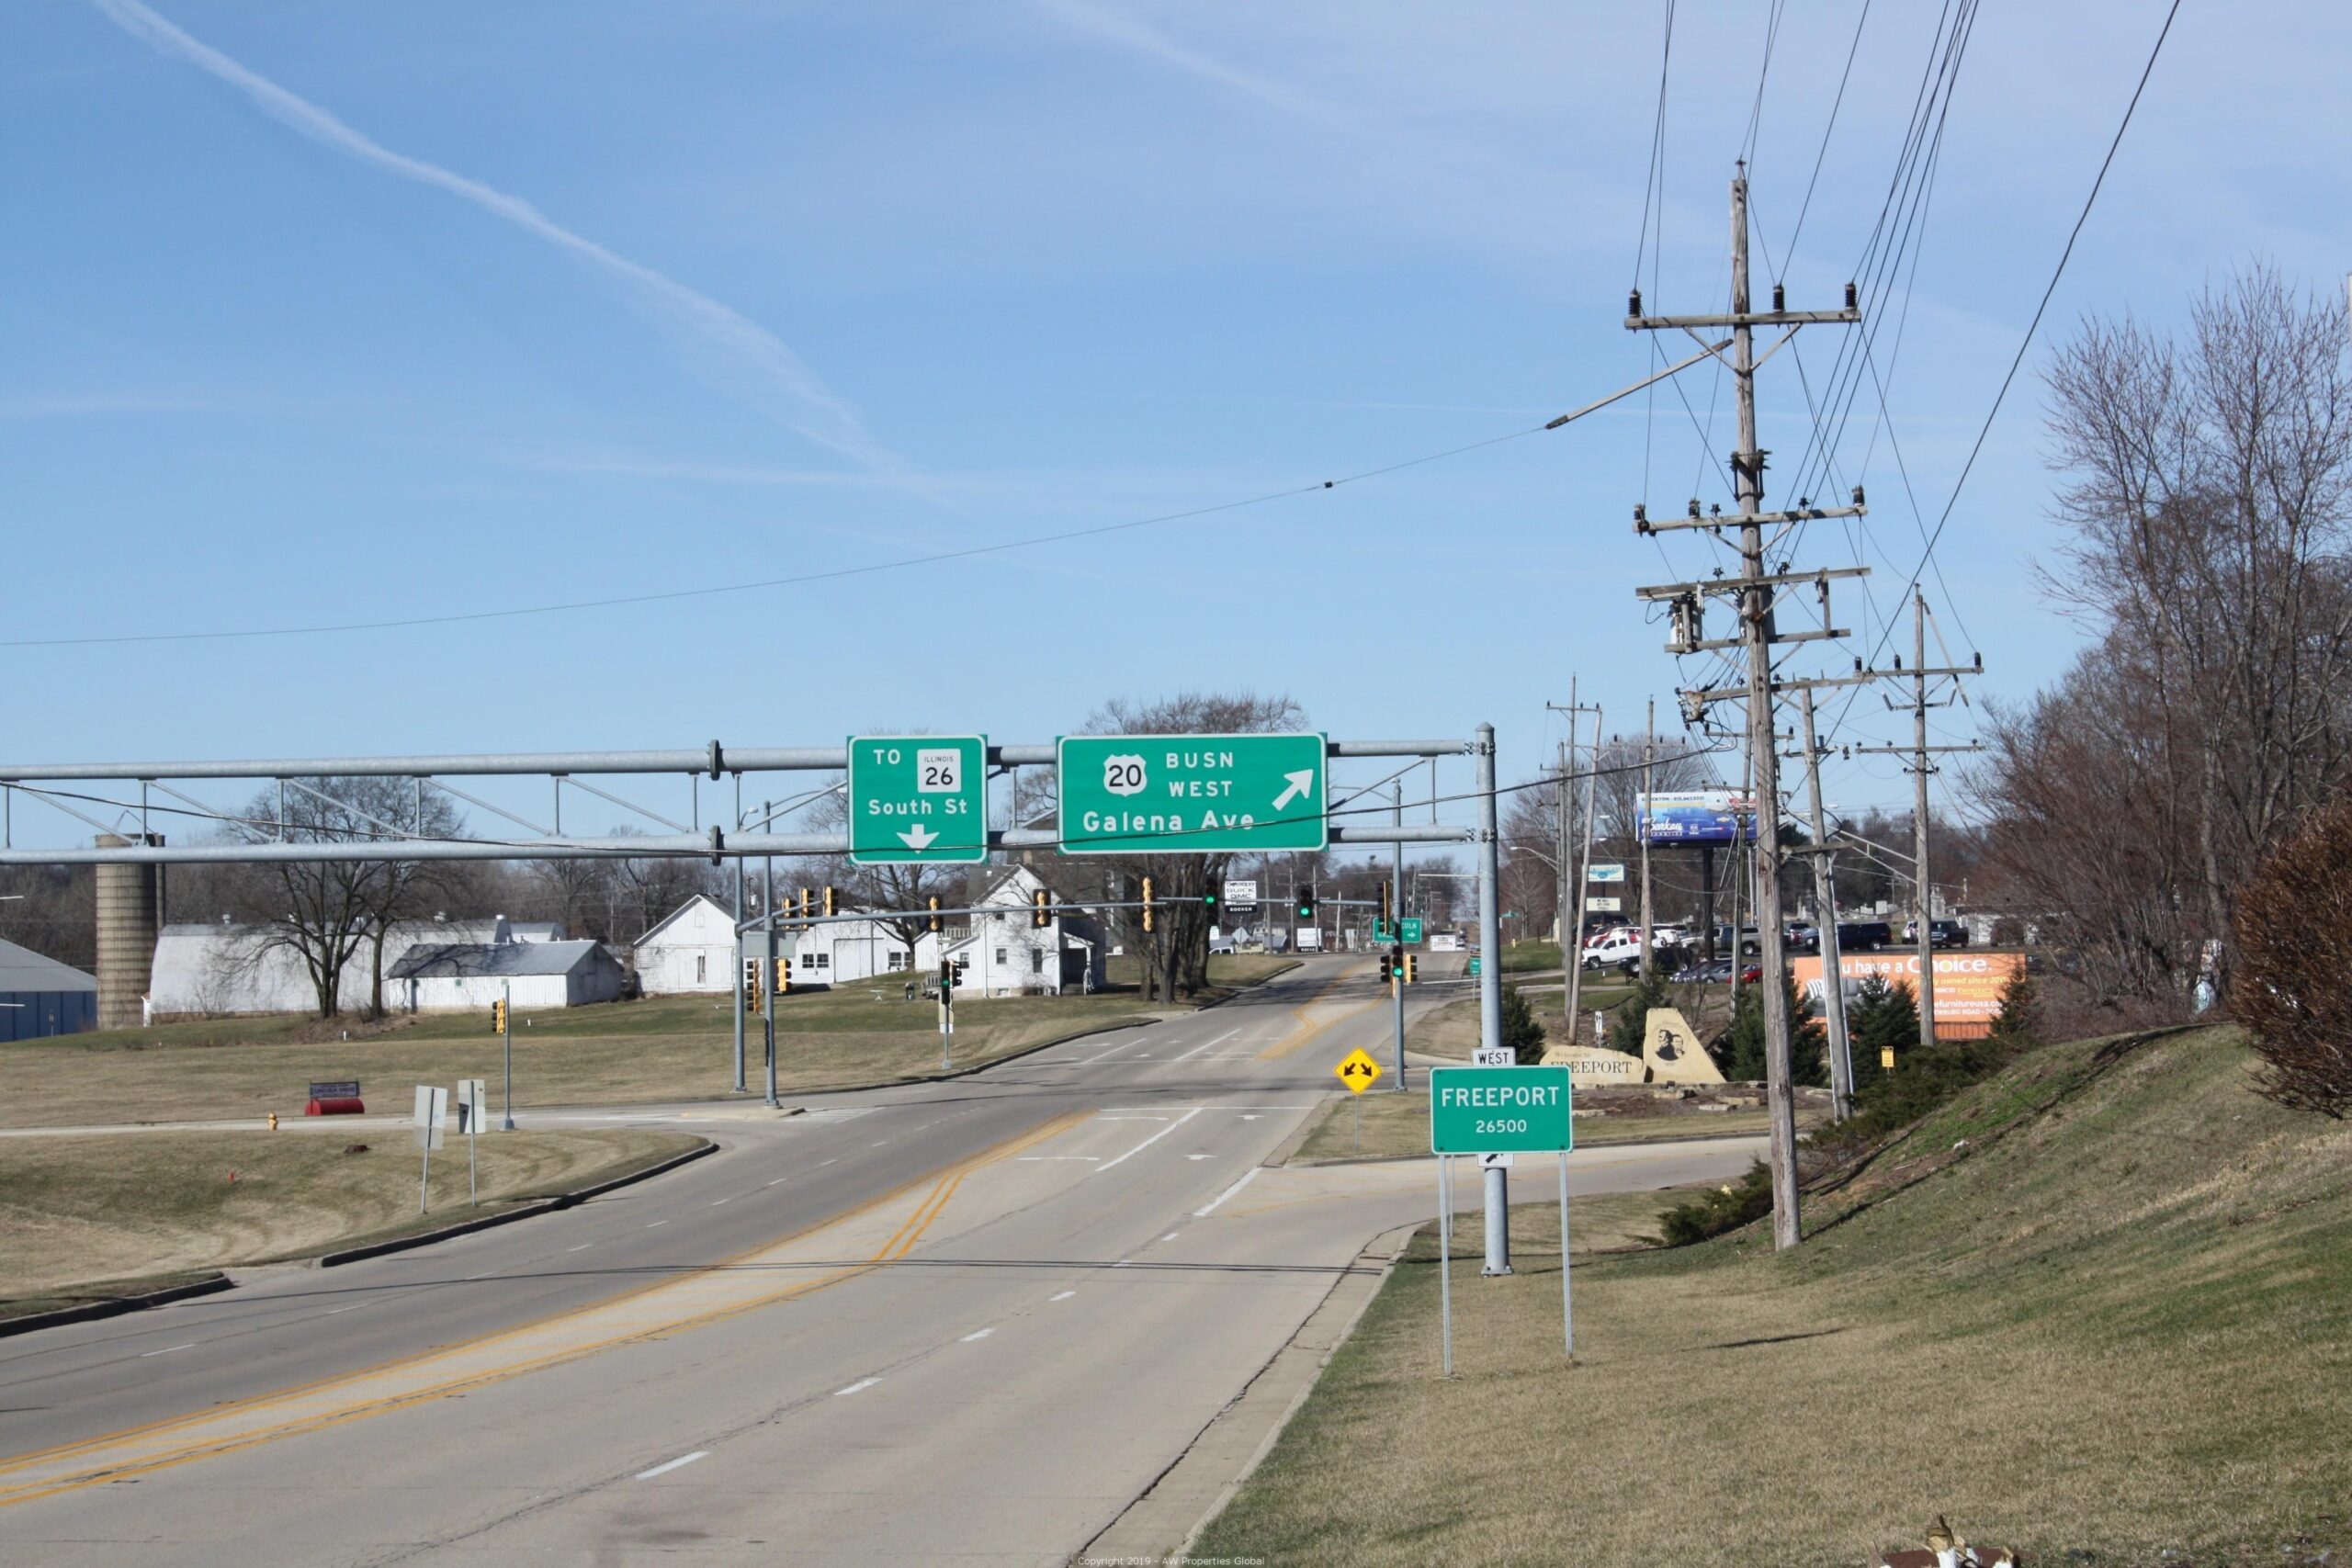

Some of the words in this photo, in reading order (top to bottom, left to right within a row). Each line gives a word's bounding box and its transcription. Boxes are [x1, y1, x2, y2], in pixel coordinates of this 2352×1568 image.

[873, 749, 901, 765] TO
[1166, 751, 1234, 769] BUSN
[925, 767, 954, 786] 26
[1108, 763, 1142, 787] 20
[1169, 780, 1233, 797] WEST
[868, 798, 933, 816] South
[944, 797, 967, 815] St
[1082, 810, 1182, 832] Galena
[1200, 809, 1255, 830] Ave
[1855, 959, 1891, 974] have
[1894, 963, 1904, 974] a
[1478, 1052, 1509, 1065] WEST
[1442, 1087, 1560, 1107] FREEPORT
[1476, 1119, 1527, 1134] 26500
